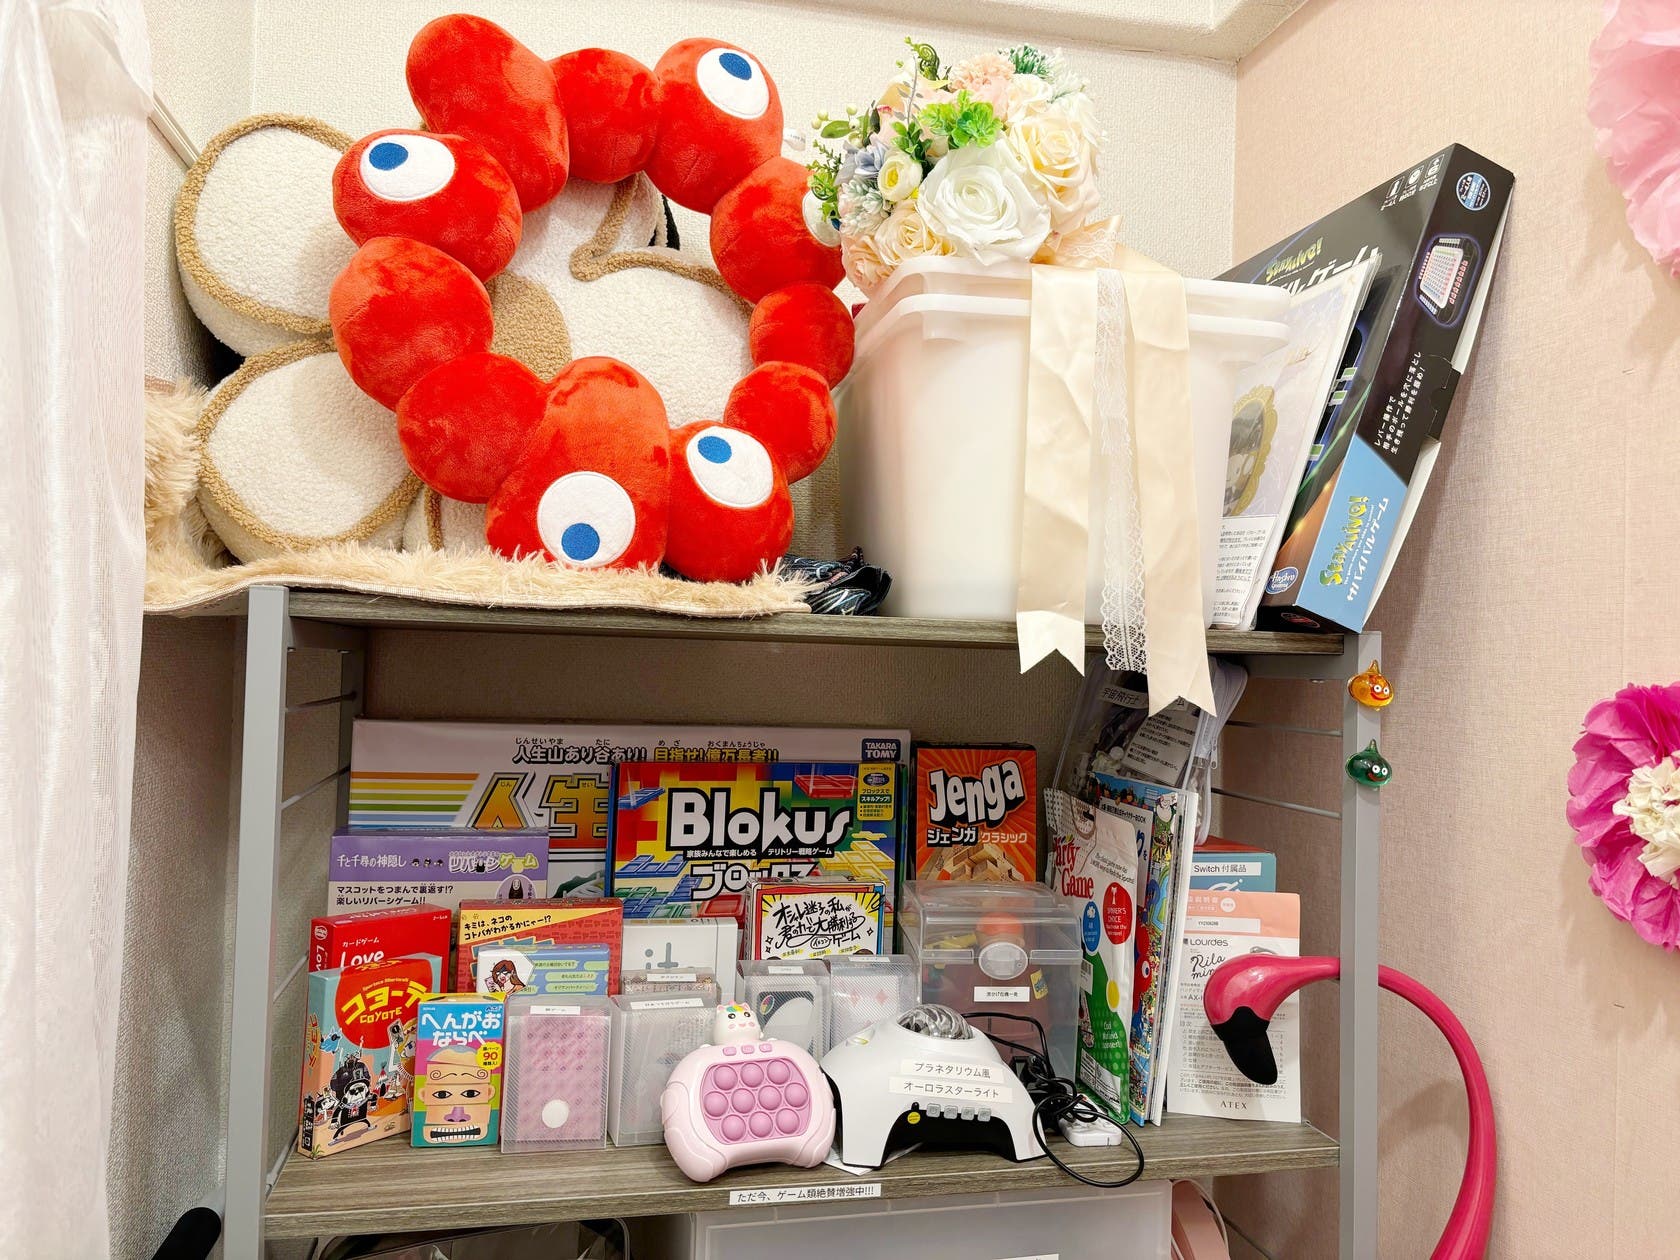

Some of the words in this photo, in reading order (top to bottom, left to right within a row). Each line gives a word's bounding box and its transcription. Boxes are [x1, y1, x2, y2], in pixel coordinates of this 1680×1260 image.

[1347, 497, 1389, 602] サバイバルゲーム
[595, 738, 611, 746] たに
[865, 742, 897, 750] TAKARA
[865, 750, 897, 759] TOMY
[929, 760, 1025, 823] Jenga
[668, 790, 852, 852] Blokus
[927, 826, 977, 844] ジェンガ
[981, 832, 1028, 843] クラシック
[336, 854, 407, 868] 千と千尋の神隠し
[686, 849, 757, 858] 家族みんなで楽しめる
[767, 848, 833, 857] テリトリー戦略ゲーム
[1193, 864, 1220, 873] Switch
[1221, 864, 1247, 873] 付属品
[337, 885, 454, 894] マスコットをつまんで裏返す!?
[1062, 868, 1095, 899] Game
[336, 896, 426, 905] 楽しいリバーシゲーム!!
[464, 914, 513, 931] キミは、ネコの
[464, 914, 553, 941] コトバがわかるかにゃー!?
[342, 937, 380, 947] カードゲーム
[832, 930, 861, 947] ゲーム
[315, 944, 326, 972] Lov
[340, 950, 385, 968] Love
[341, 980, 428, 1026] コヨーテ
[359, 1006, 403, 1024] COYOTE
[421, 1010, 502, 1030] へんがお
[432, 1030, 488, 1047] ならべ
[482, 1051, 499, 1061] 90
[914, 1062, 991, 1080] プラネタリウム風
[903, 1081, 999, 1099] オーロラスターライト
[1220, 1100, 1248, 1110] ATEX
[737, 1186, 874, 1203] ただ今、ゲーム類絶賛増強中!!!
